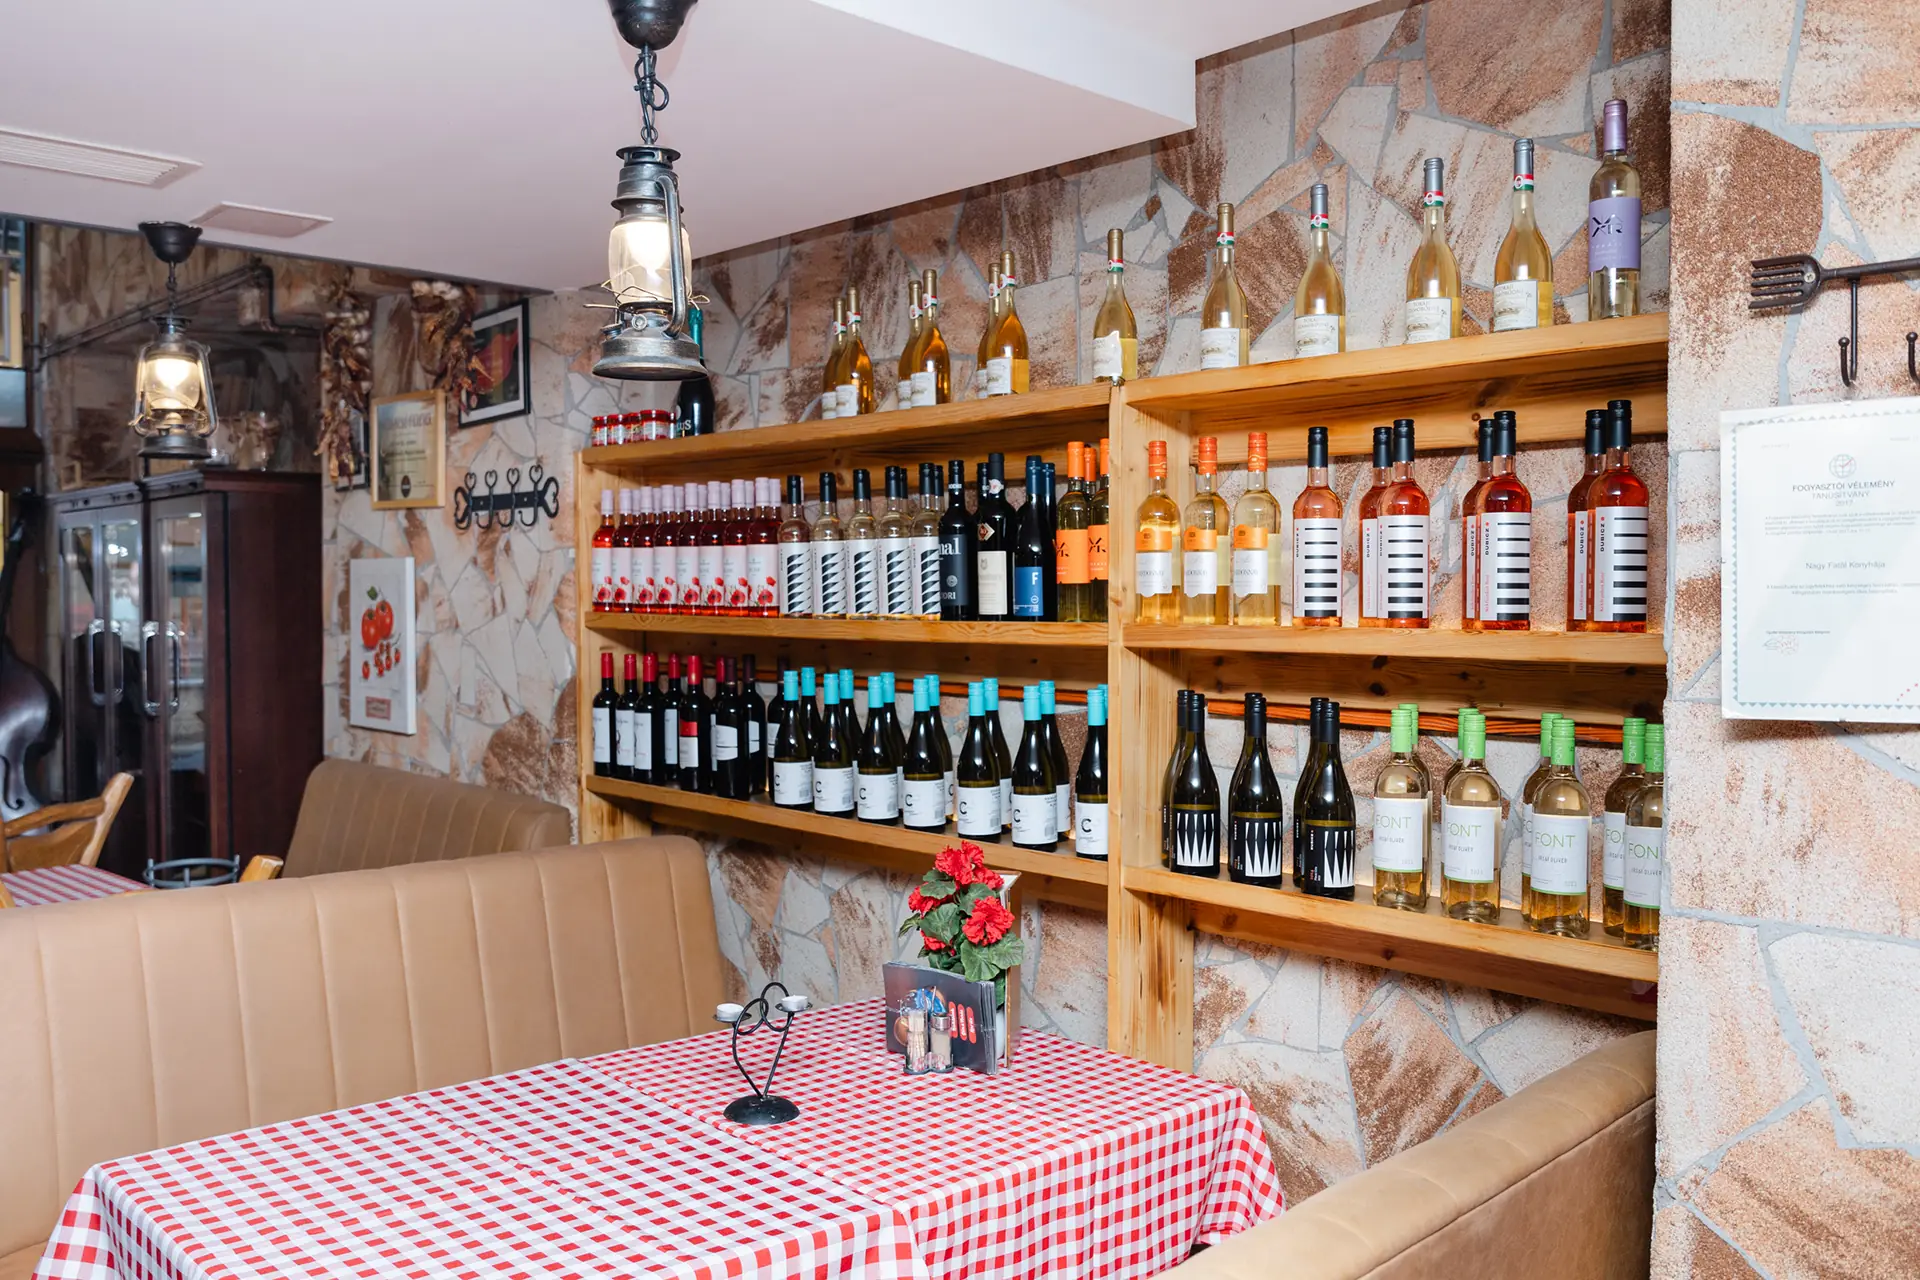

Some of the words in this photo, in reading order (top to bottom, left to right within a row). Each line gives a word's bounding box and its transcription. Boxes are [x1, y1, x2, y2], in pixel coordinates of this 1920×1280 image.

[1806, 562, 1826, 571] Nagy
[1032, 572, 1039, 585] F
[1376, 814, 1412, 829] FONT
[1447, 822, 1482, 837] FONT
[1535, 832, 1576, 848] FONT
[1629, 842, 1658, 859] FON
